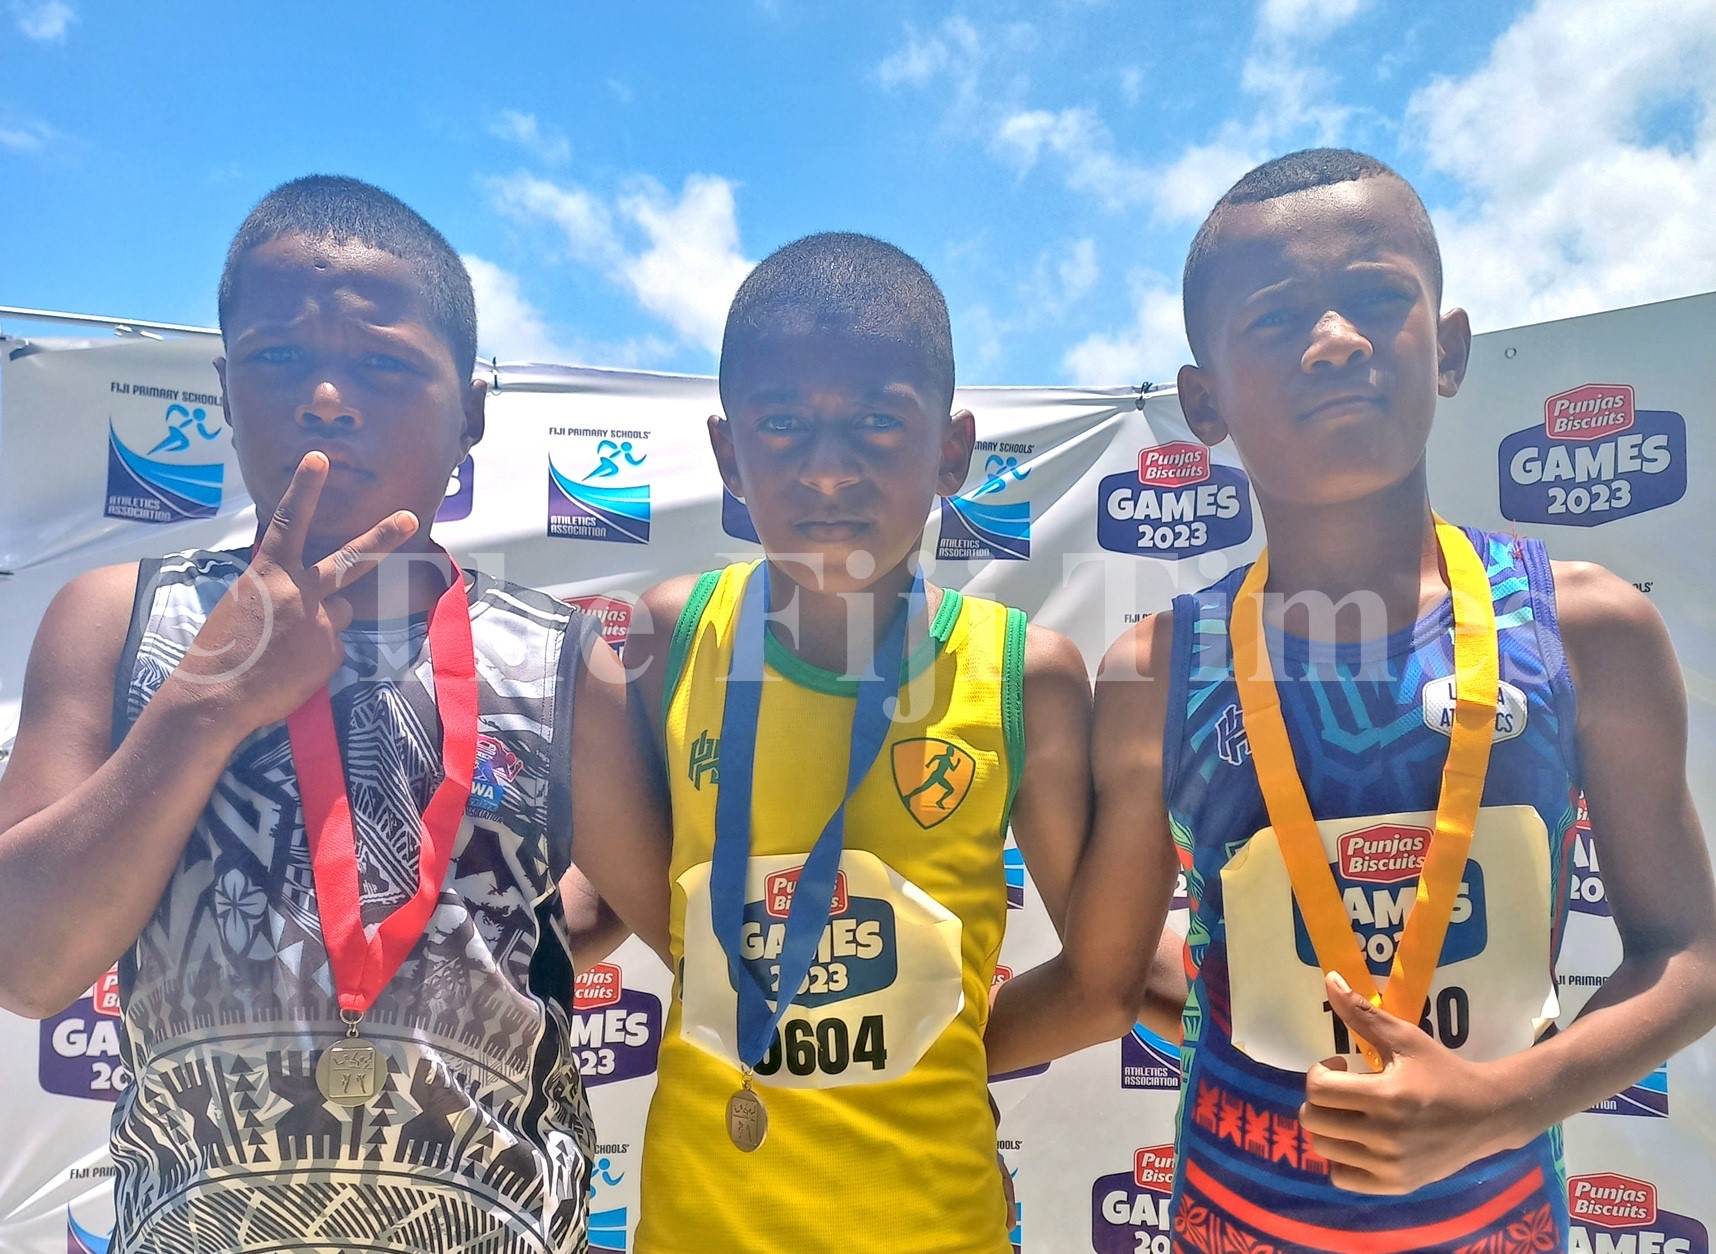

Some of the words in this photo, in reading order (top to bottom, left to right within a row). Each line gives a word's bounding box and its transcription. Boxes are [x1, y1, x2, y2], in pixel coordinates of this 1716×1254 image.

[111, 382, 130, 395] FIJI
[132, 384, 179, 400] PRIMARY
[182, 391, 223, 406] SCHOOL
[1554, 394, 1624, 417] Punjas
[1553, 411, 1625, 433] Biscuits
[549, 427, 565, 436] FIJI
[568, 428, 608, 438] PRIMARY
[975, 440, 998, 453] MARY
[1144, 450, 1203, 467] Punjas
[1510, 434, 1671, 485] GAMES
[1144, 465, 1204, 480] Biscuits
[109, 495, 160, 511] ATHLETICS
[1107, 485, 1240, 523] GAMES
[1547, 480, 1632, 514] 2023
[108, 505, 172, 521] ASSOCIATION
[550, 515, 597, 527] ATHLETICS
[550, 524, 607, 537] ASSOCIATION
[1136, 522, 1208, 549] 2023
[940, 538, 980, 549] ATHLETICS
[939, 547, 990, 558] ASSOCIATION
[1347, 836, 1424, 856] Punjas
[1347, 856, 1426, 873] Biscuits
[571, 1009, 650, 1049] MES
[1124, 1066, 1169, 1077] ATHLETICS
[1124, 1076, 1179, 1087] ASSOCIATION
[594, 1143, 630, 1155] CHOOLS'
[70, 1168, 90, 1180] FIJI
[1574, 1181, 1648, 1204] Punjas
[1574, 1199, 1648, 1219] Biscuits
[1569, 1226, 1690, 1254] AMES
